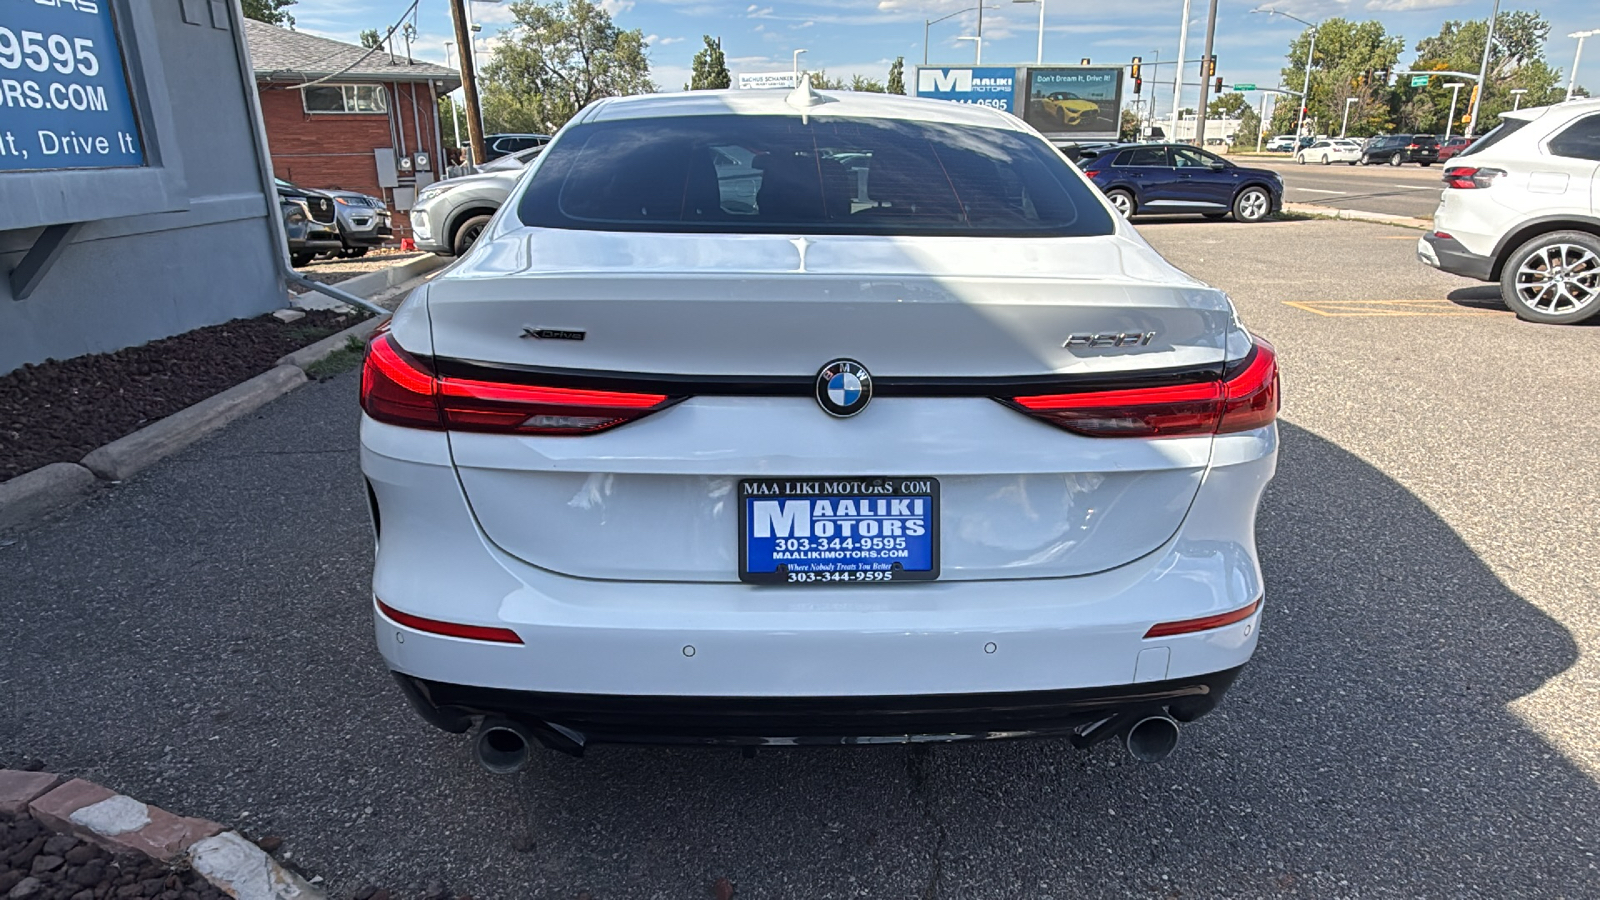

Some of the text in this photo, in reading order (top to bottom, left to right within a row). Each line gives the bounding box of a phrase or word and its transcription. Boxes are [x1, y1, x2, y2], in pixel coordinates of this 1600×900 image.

[0, 26, 99, 76] 9595
[0, 79, 109, 111] RS.COM
[37, 130, 109, 155] Drive
[117, 131, 136, 154] It
[823, 363, 868, 381] BMW
[824, 482, 893, 494] MOTORS
[775, 537, 906, 551] 303-344-9595
[773, 550, 909, 559] MAALIKIMOTORS.COM
[811, 563, 835, 571] Nobody
[872, 562, 892, 570] Better
[787, 571, 893, 582] 303-344-9595
